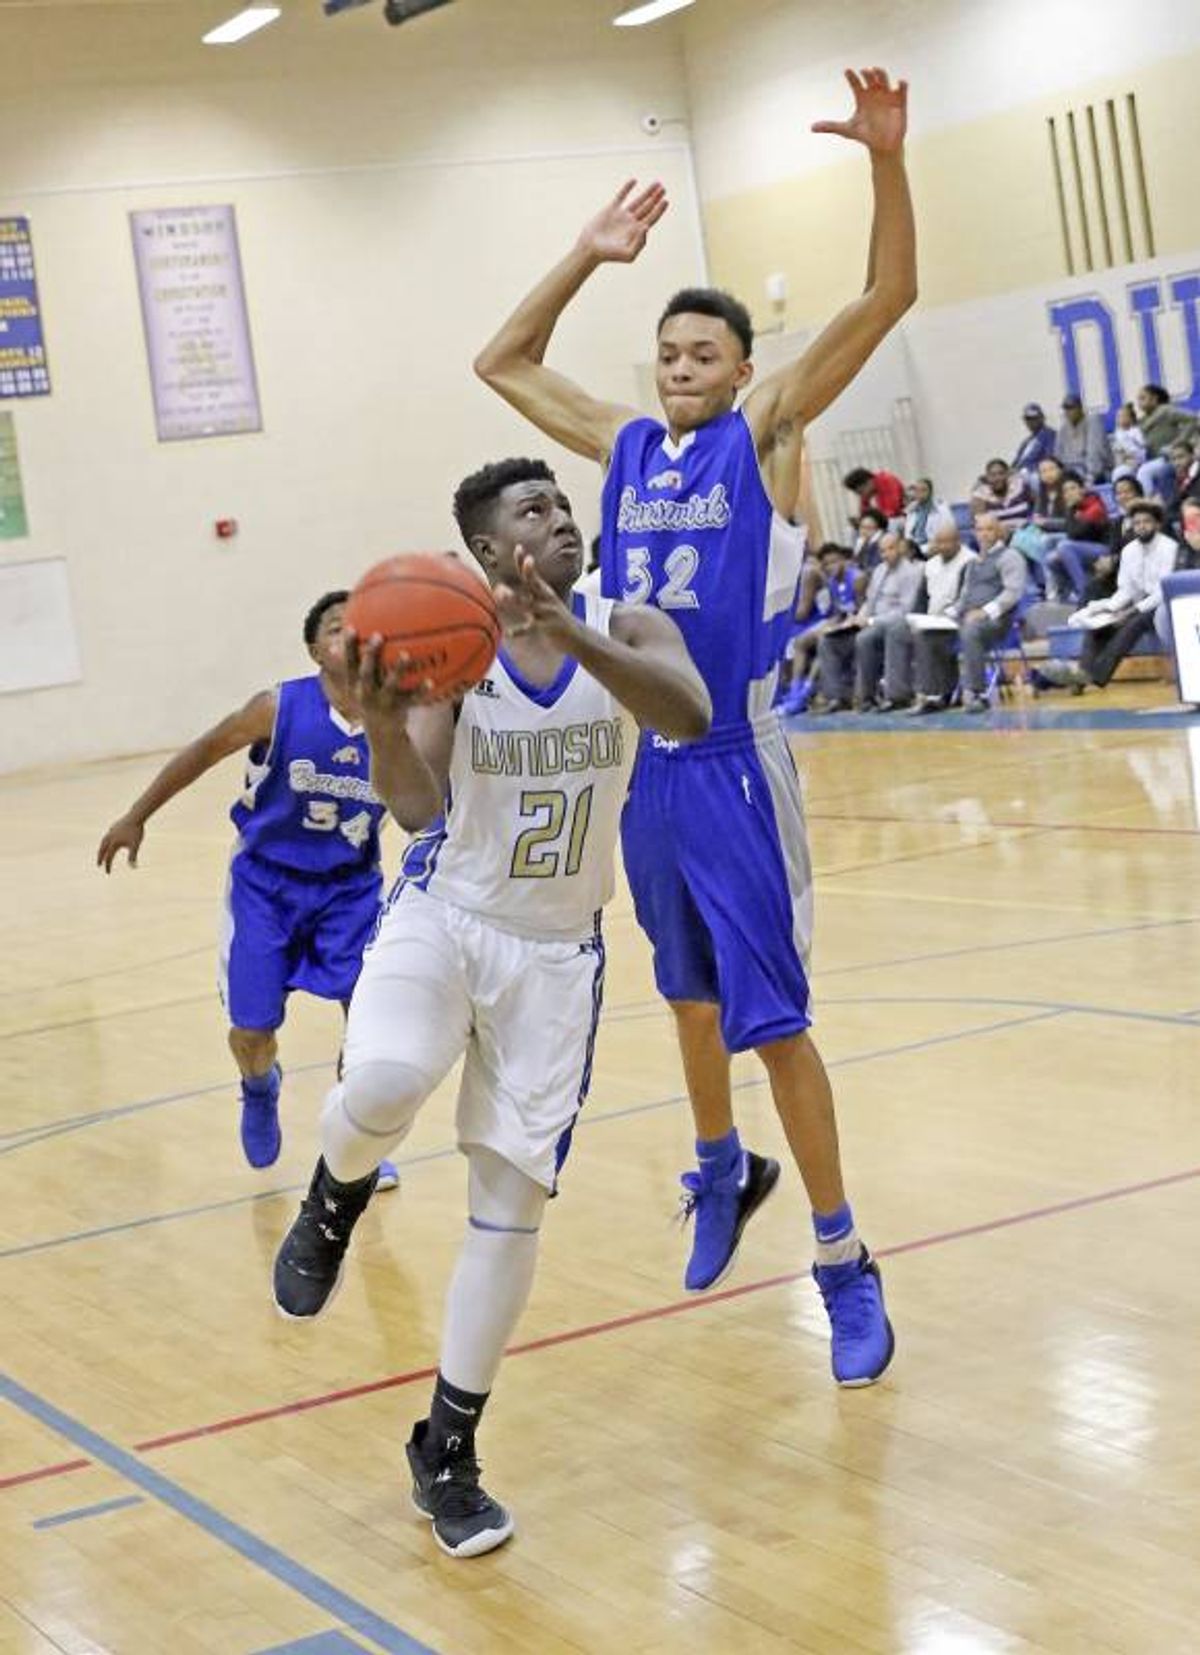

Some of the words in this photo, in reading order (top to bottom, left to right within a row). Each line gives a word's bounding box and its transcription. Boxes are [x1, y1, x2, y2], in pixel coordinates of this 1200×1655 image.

[623, 544, 700, 609] 32
[302, 800, 372, 848] 34
[509, 784, 594, 878] 21
